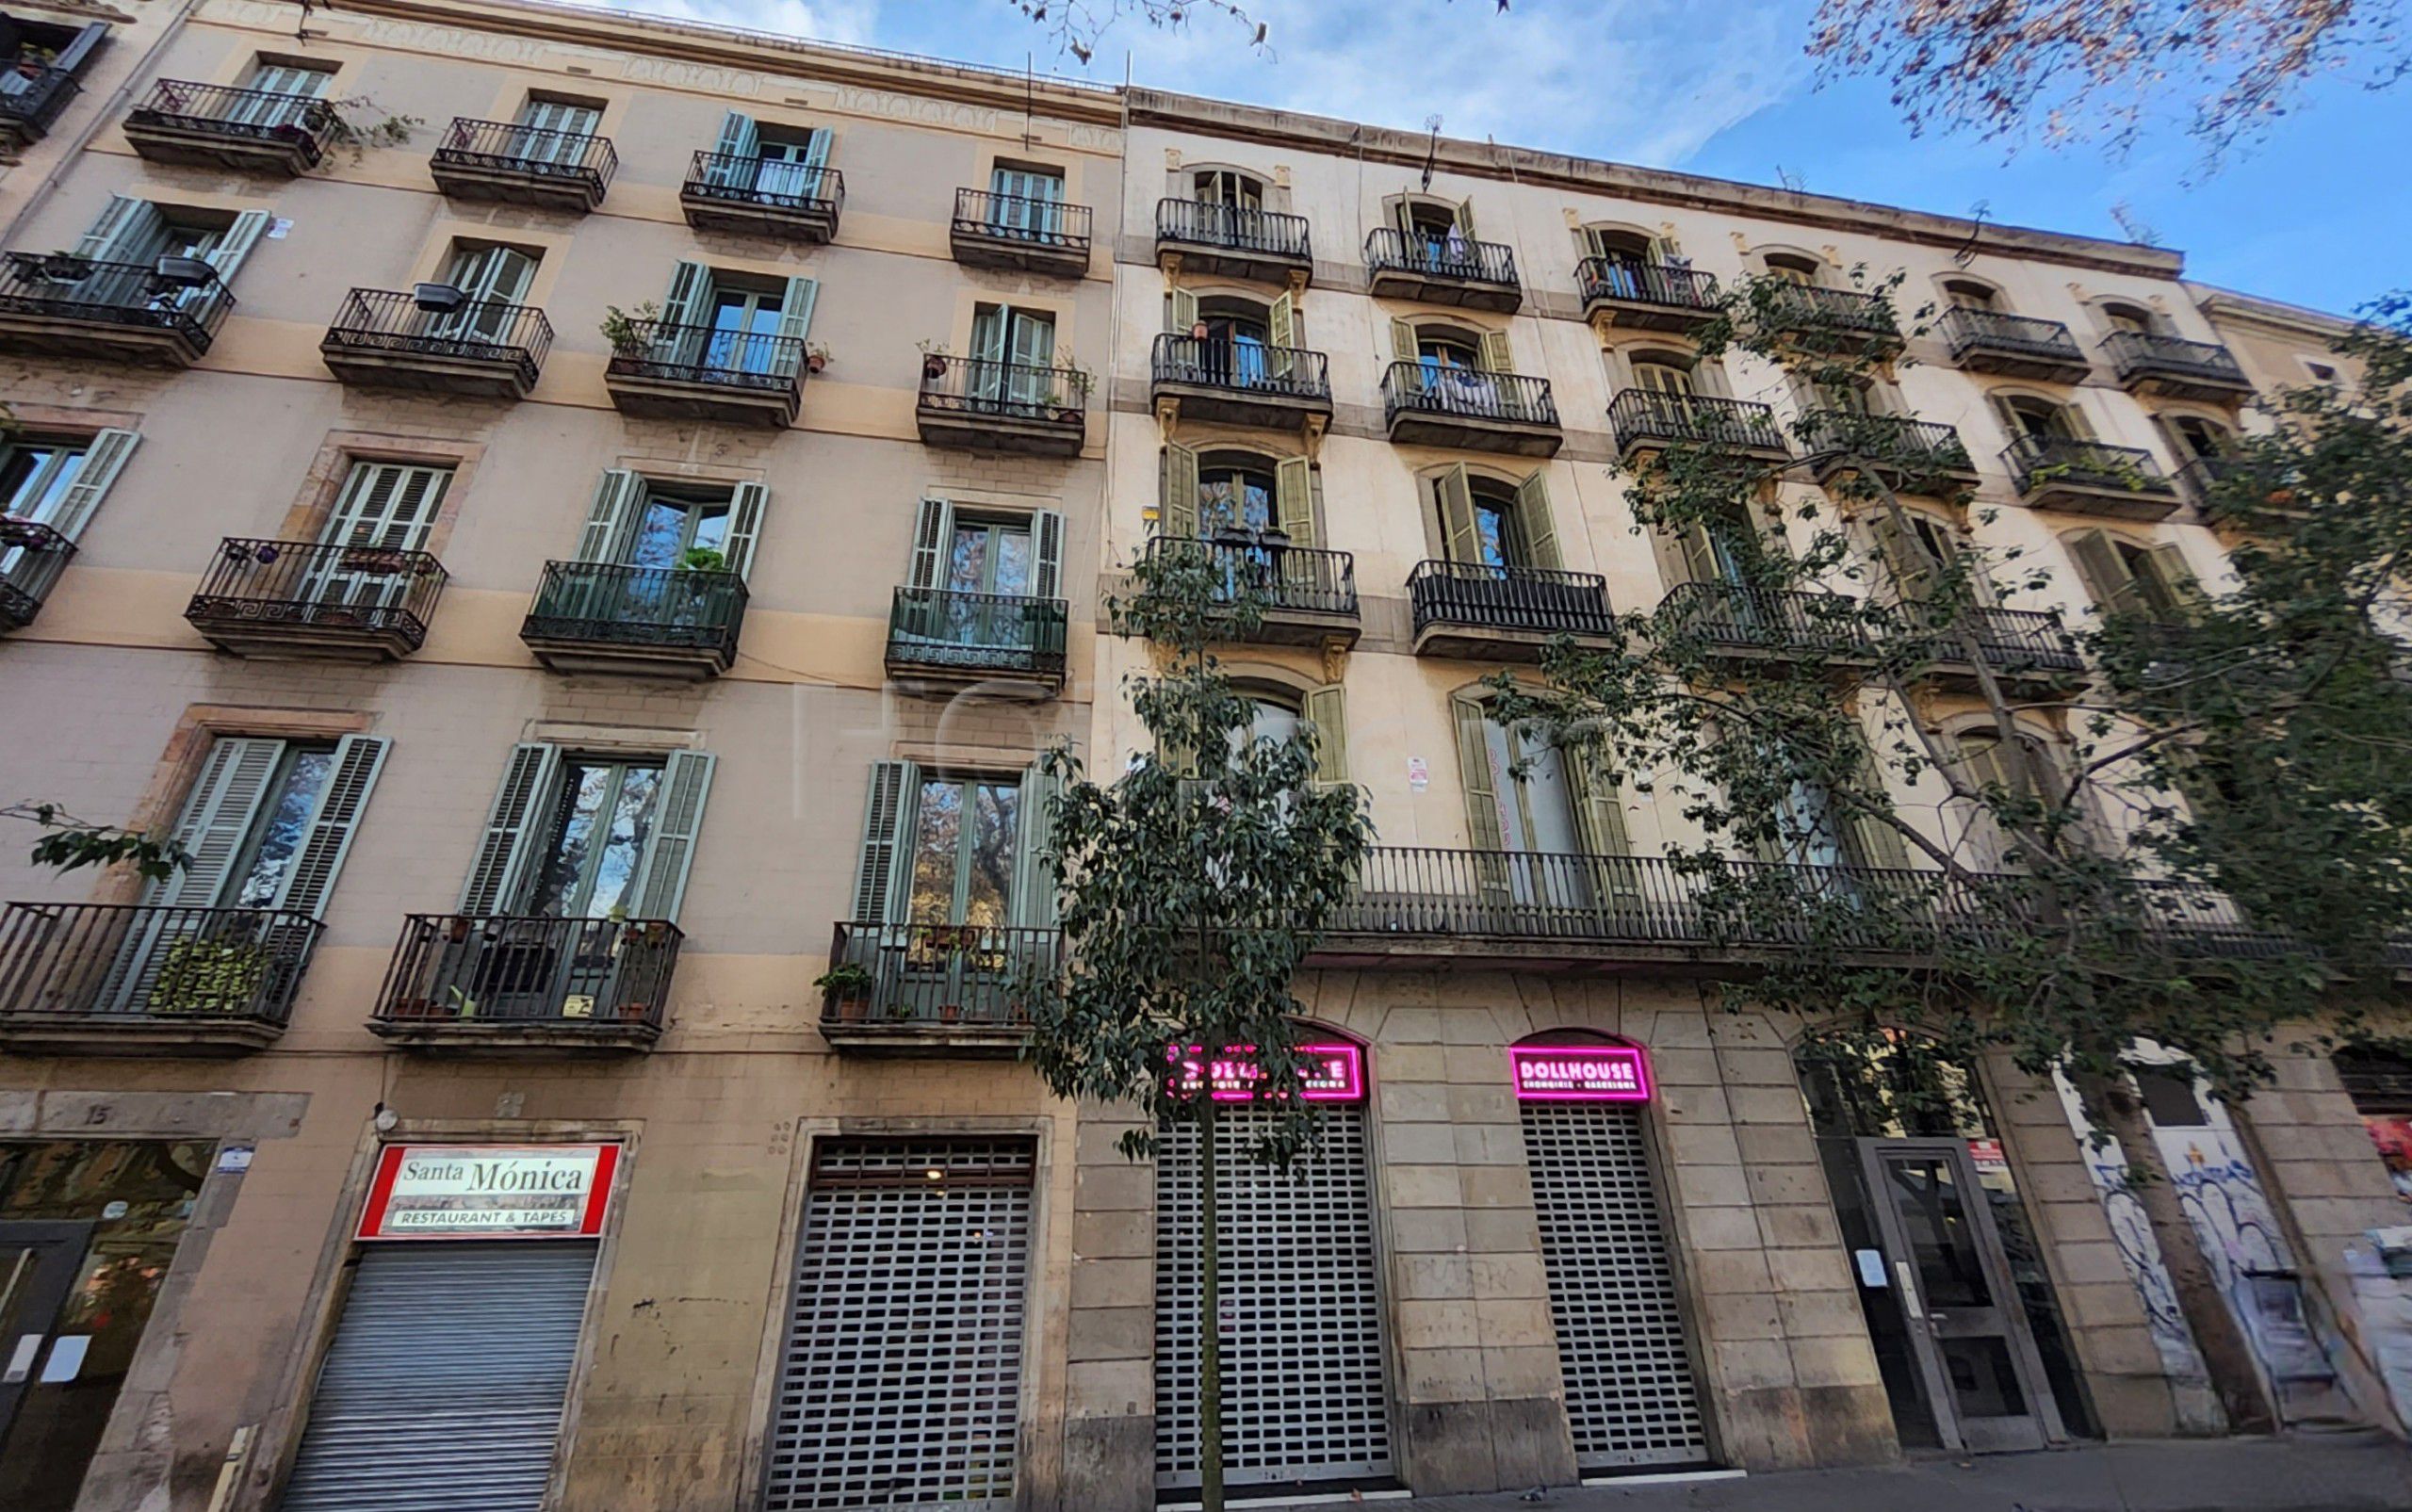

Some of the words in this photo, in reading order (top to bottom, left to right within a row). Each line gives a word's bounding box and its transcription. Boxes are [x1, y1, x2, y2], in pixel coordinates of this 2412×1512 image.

[1520, 1061, 1635, 1081] DOLLHOUSE
[84, 1103, 113, 1126] 15
[403, 1161, 464, 1181] Santa
[466, 1160, 582, 1192] Mónica
[400, 1211, 500, 1225] RESTAURANT
[505, 1211, 515, 1223] &
[524, 1211, 567, 1223] TAPES
